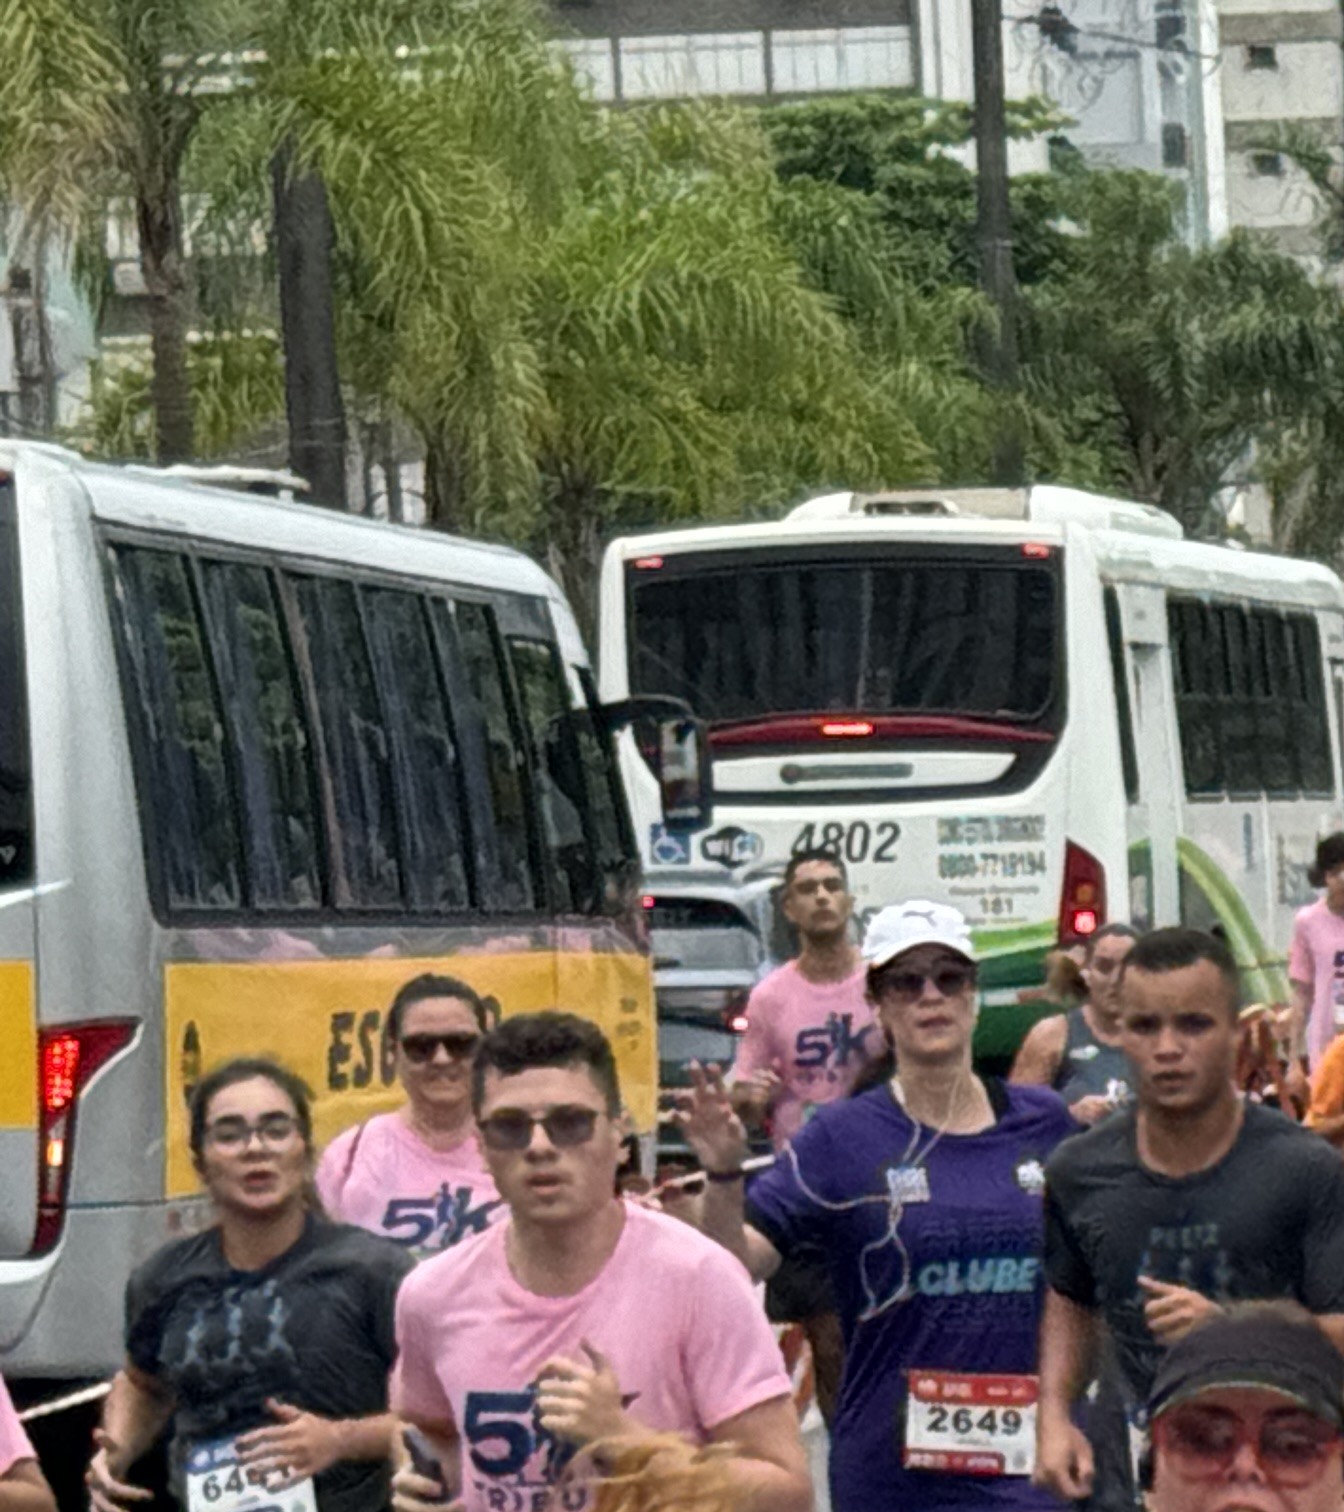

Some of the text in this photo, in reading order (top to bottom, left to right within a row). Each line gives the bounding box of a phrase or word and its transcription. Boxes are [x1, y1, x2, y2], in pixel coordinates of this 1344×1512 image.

[792, 821, 900, 863] 4802
[918, 1257, 1039, 1296] CLUBE
[926, 1405, 1023, 1437] 2649
